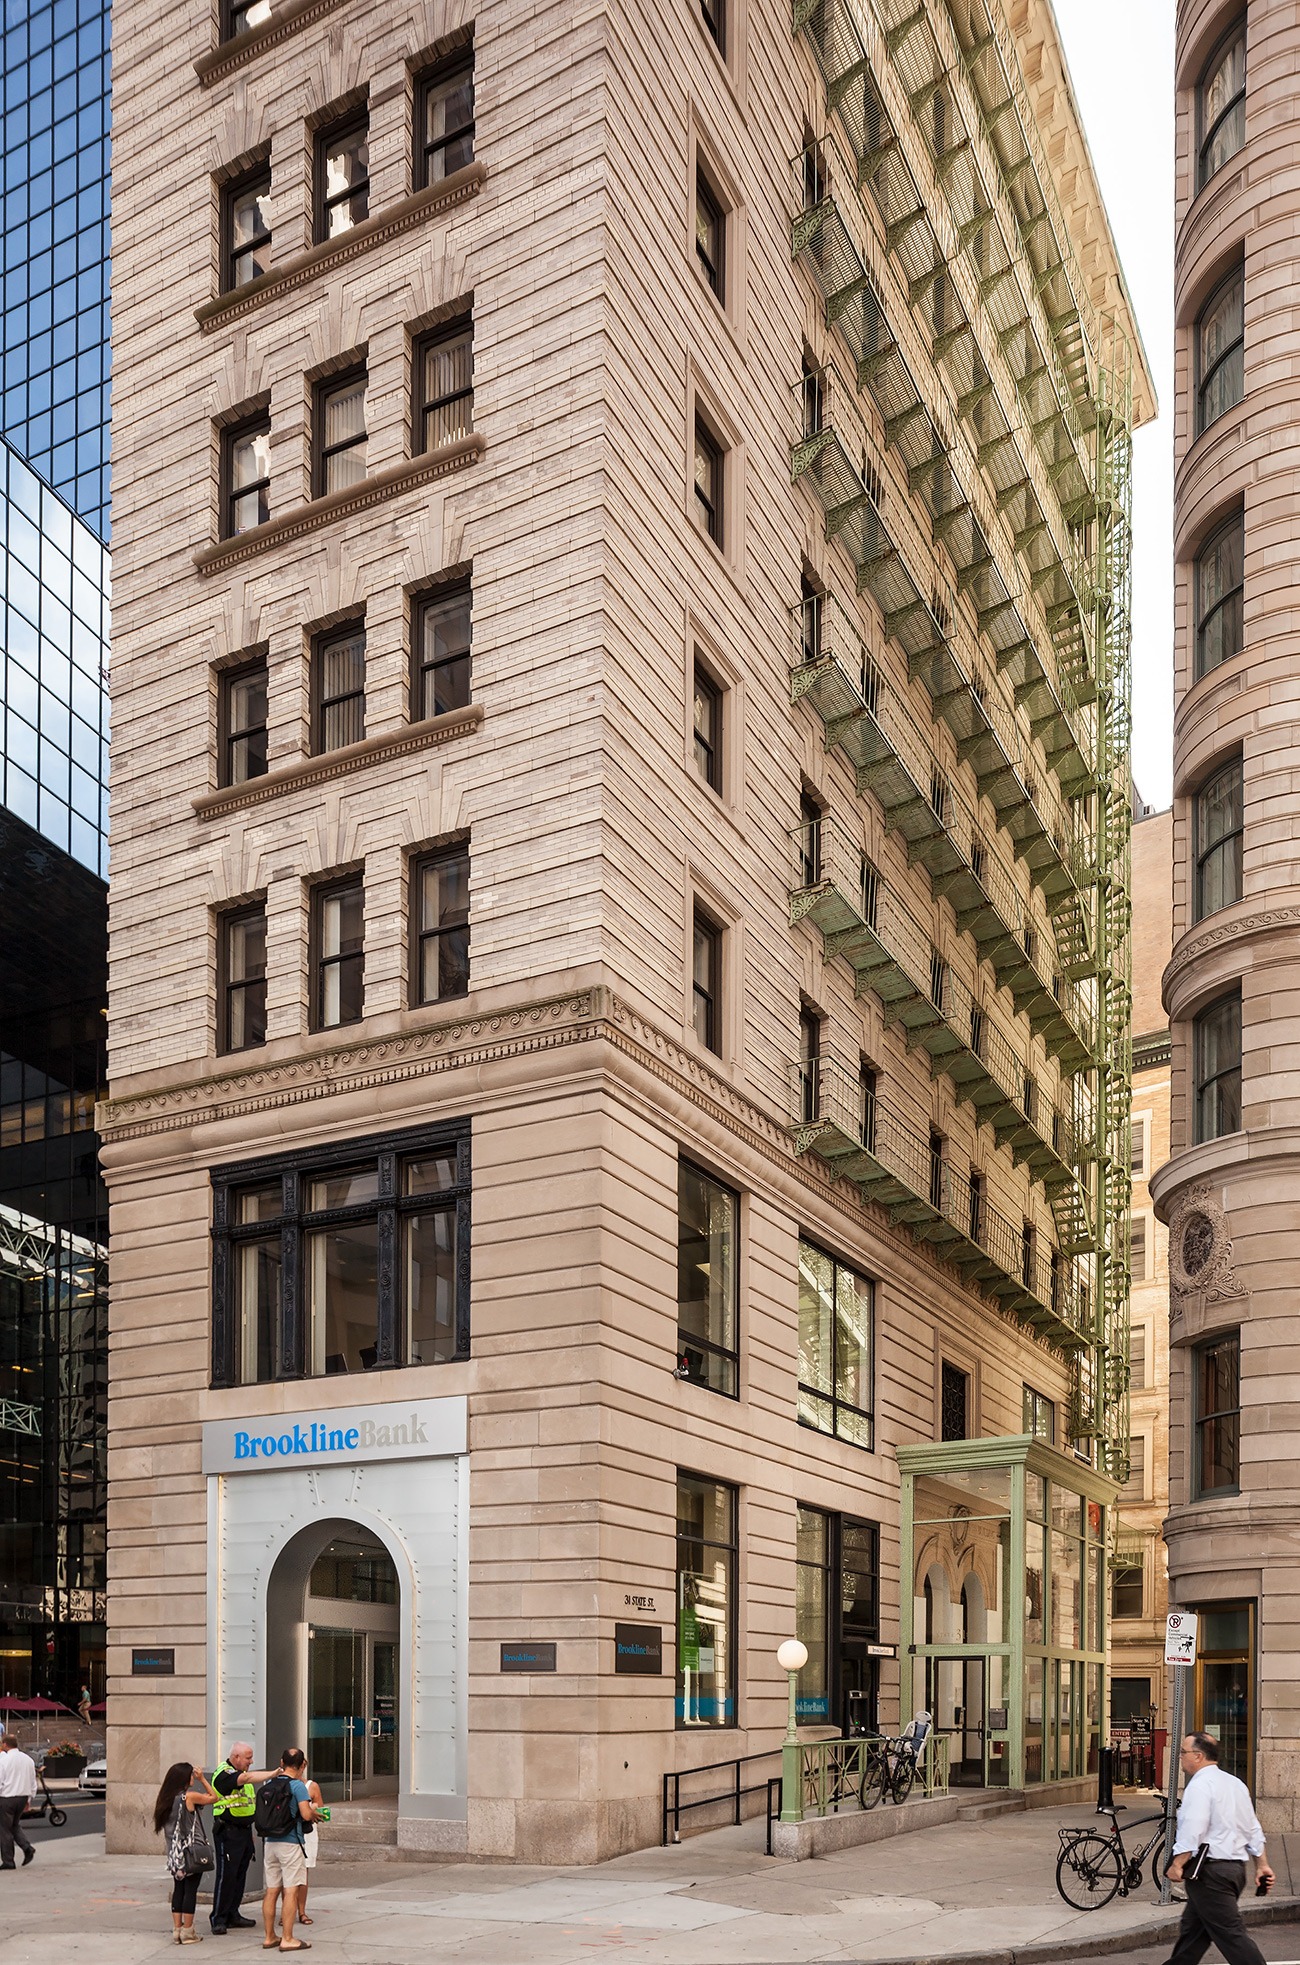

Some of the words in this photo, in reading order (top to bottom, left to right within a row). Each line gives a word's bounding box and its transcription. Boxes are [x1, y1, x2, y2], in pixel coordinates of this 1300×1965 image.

[233, 1413, 429, 1459] BrooklineBank
[632, 1596, 646, 1606] STATE
[618, 1643, 660, 1656] BrooklineBank
